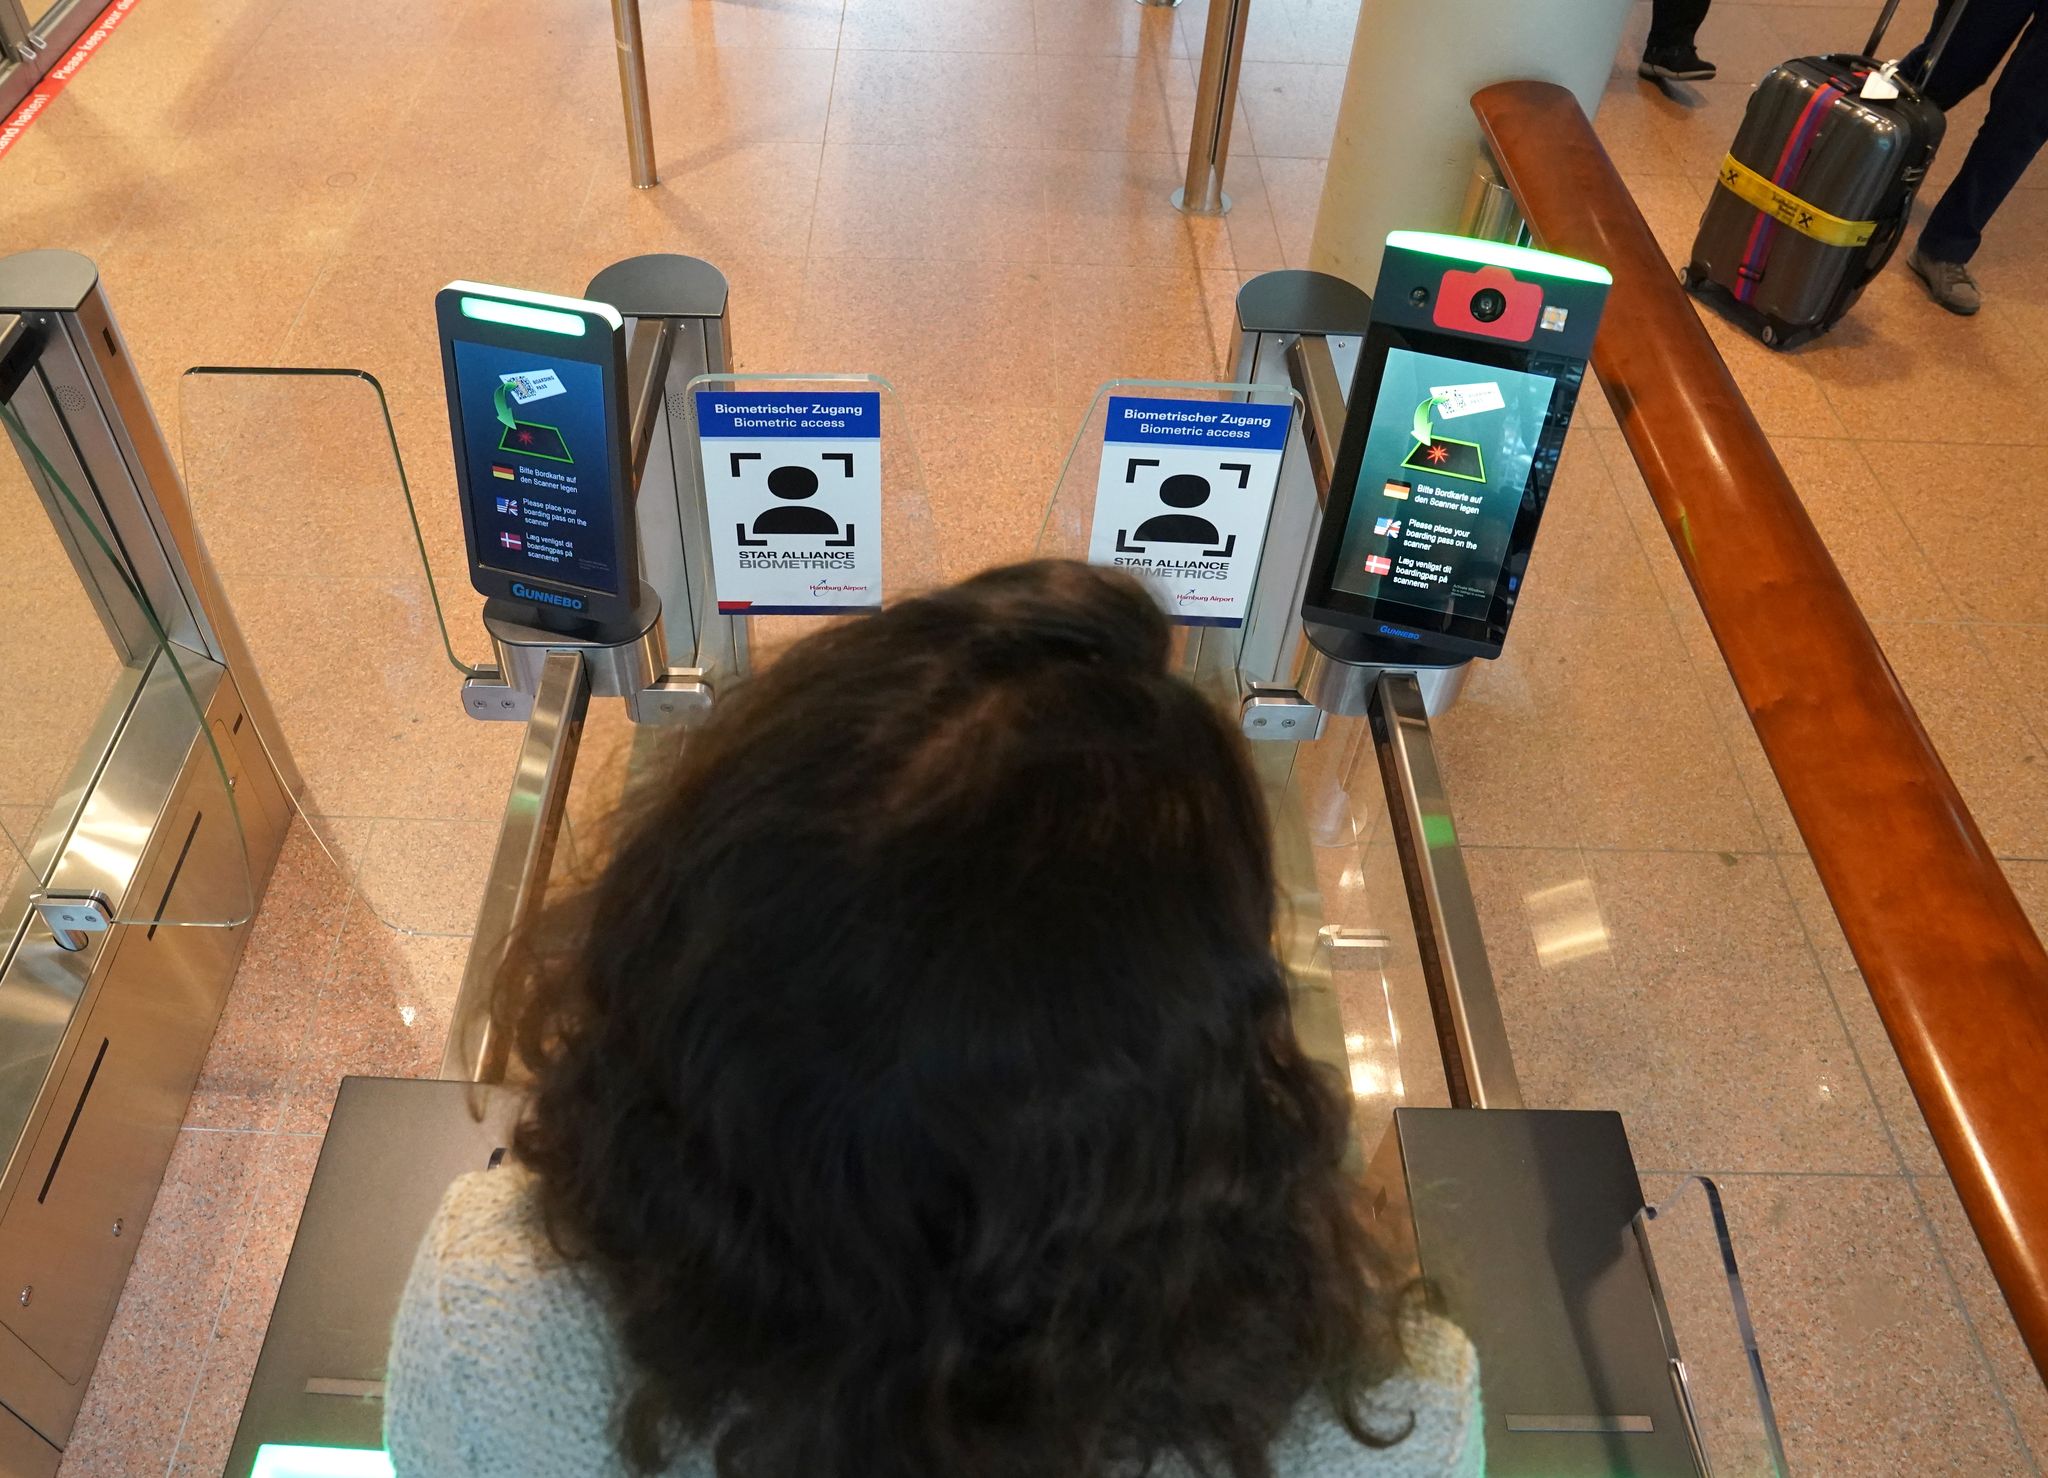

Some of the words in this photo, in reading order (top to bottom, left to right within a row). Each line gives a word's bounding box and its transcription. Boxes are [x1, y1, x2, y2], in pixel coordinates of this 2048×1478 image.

[9, 94, 50, 126] halten!
[52, 51, 88, 80] Please
[78, 30, 107, 51] keep
[99, 10, 122, 29] your
[715, 404, 808, 414] Biometrischer
[812, 404, 863, 416] Zugang
[1124, 408, 1218, 423] Biometrischer
[1220, 414, 1272, 428] Zugang
[734, 418, 797, 428] Biometric
[800, 419, 845, 428] access
[1140, 424, 1203, 436] Biometric
[1206, 429, 1250, 438] access
[519, 466, 534, 475] Bitte
[534, 468, 565, 481] Bordkarte
[566, 476, 577, 484] auf
[520, 476, 532, 484] den
[534, 478, 559, 489] Scanner
[560, 483, 578, 493] legen
[1417, 484, 1433, 495] Bitte
[1435, 487, 1469, 502] Bordkarte
[1470, 496, 1483, 504] auf
[522, 498, 544, 509] Please
[545, 503, 562, 512] place
[562, 507, 577, 515] your
[1414, 495, 1428, 504] den
[1429, 498, 1459, 511] Scanner
[1460, 503, 1480, 515] legen
[524, 508, 550, 520] boarding
[551, 514, 566, 522] pass
[577, 518, 587, 526] the
[524, 517, 549, 527] scanner
[1408, 518, 1433, 530] Please
[1433, 525, 1453, 534] place
[1453, 529, 1471, 538] your
[525, 532, 540, 543] Læg
[540, 537, 564, 547] venligst
[565, 540, 573, 548] dit
[1403, 539, 1432, 551] scanner
[1406, 529, 1437, 543] boarding
[1437, 537, 1454, 546] pass
[1466, 541, 1477, 550] the
[527, 542, 564, 555] boardingpas
[564, 549, 573, 558] på
[528, 551, 560, 562] scanneren
[739, 551, 777, 559] STAR
[782, 551, 854, 559] ALLIANCE
[740, 560, 855, 569] BIOMETRICS
[1114, 558, 1152, 566] STAR
[1156, 560, 1230, 570] ALLIANCE
[1398, 555, 1414, 568] Læg
[1416, 561, 1442, 572] venligst
[1443, 564, 1452, 574] dit
[1393, 576, 1429, 590] scanneren
[1396, 566, 1438, 582] boardingpas
[1438, 574, 1448, 584] på
[512, 583, 582, 610] GUNNEBO
[1176, 594, 1208, 602] Hamburg
[1210, 595, 1234, 603] Airport
[1380, 625, 1420, 640] GUNNEBO
